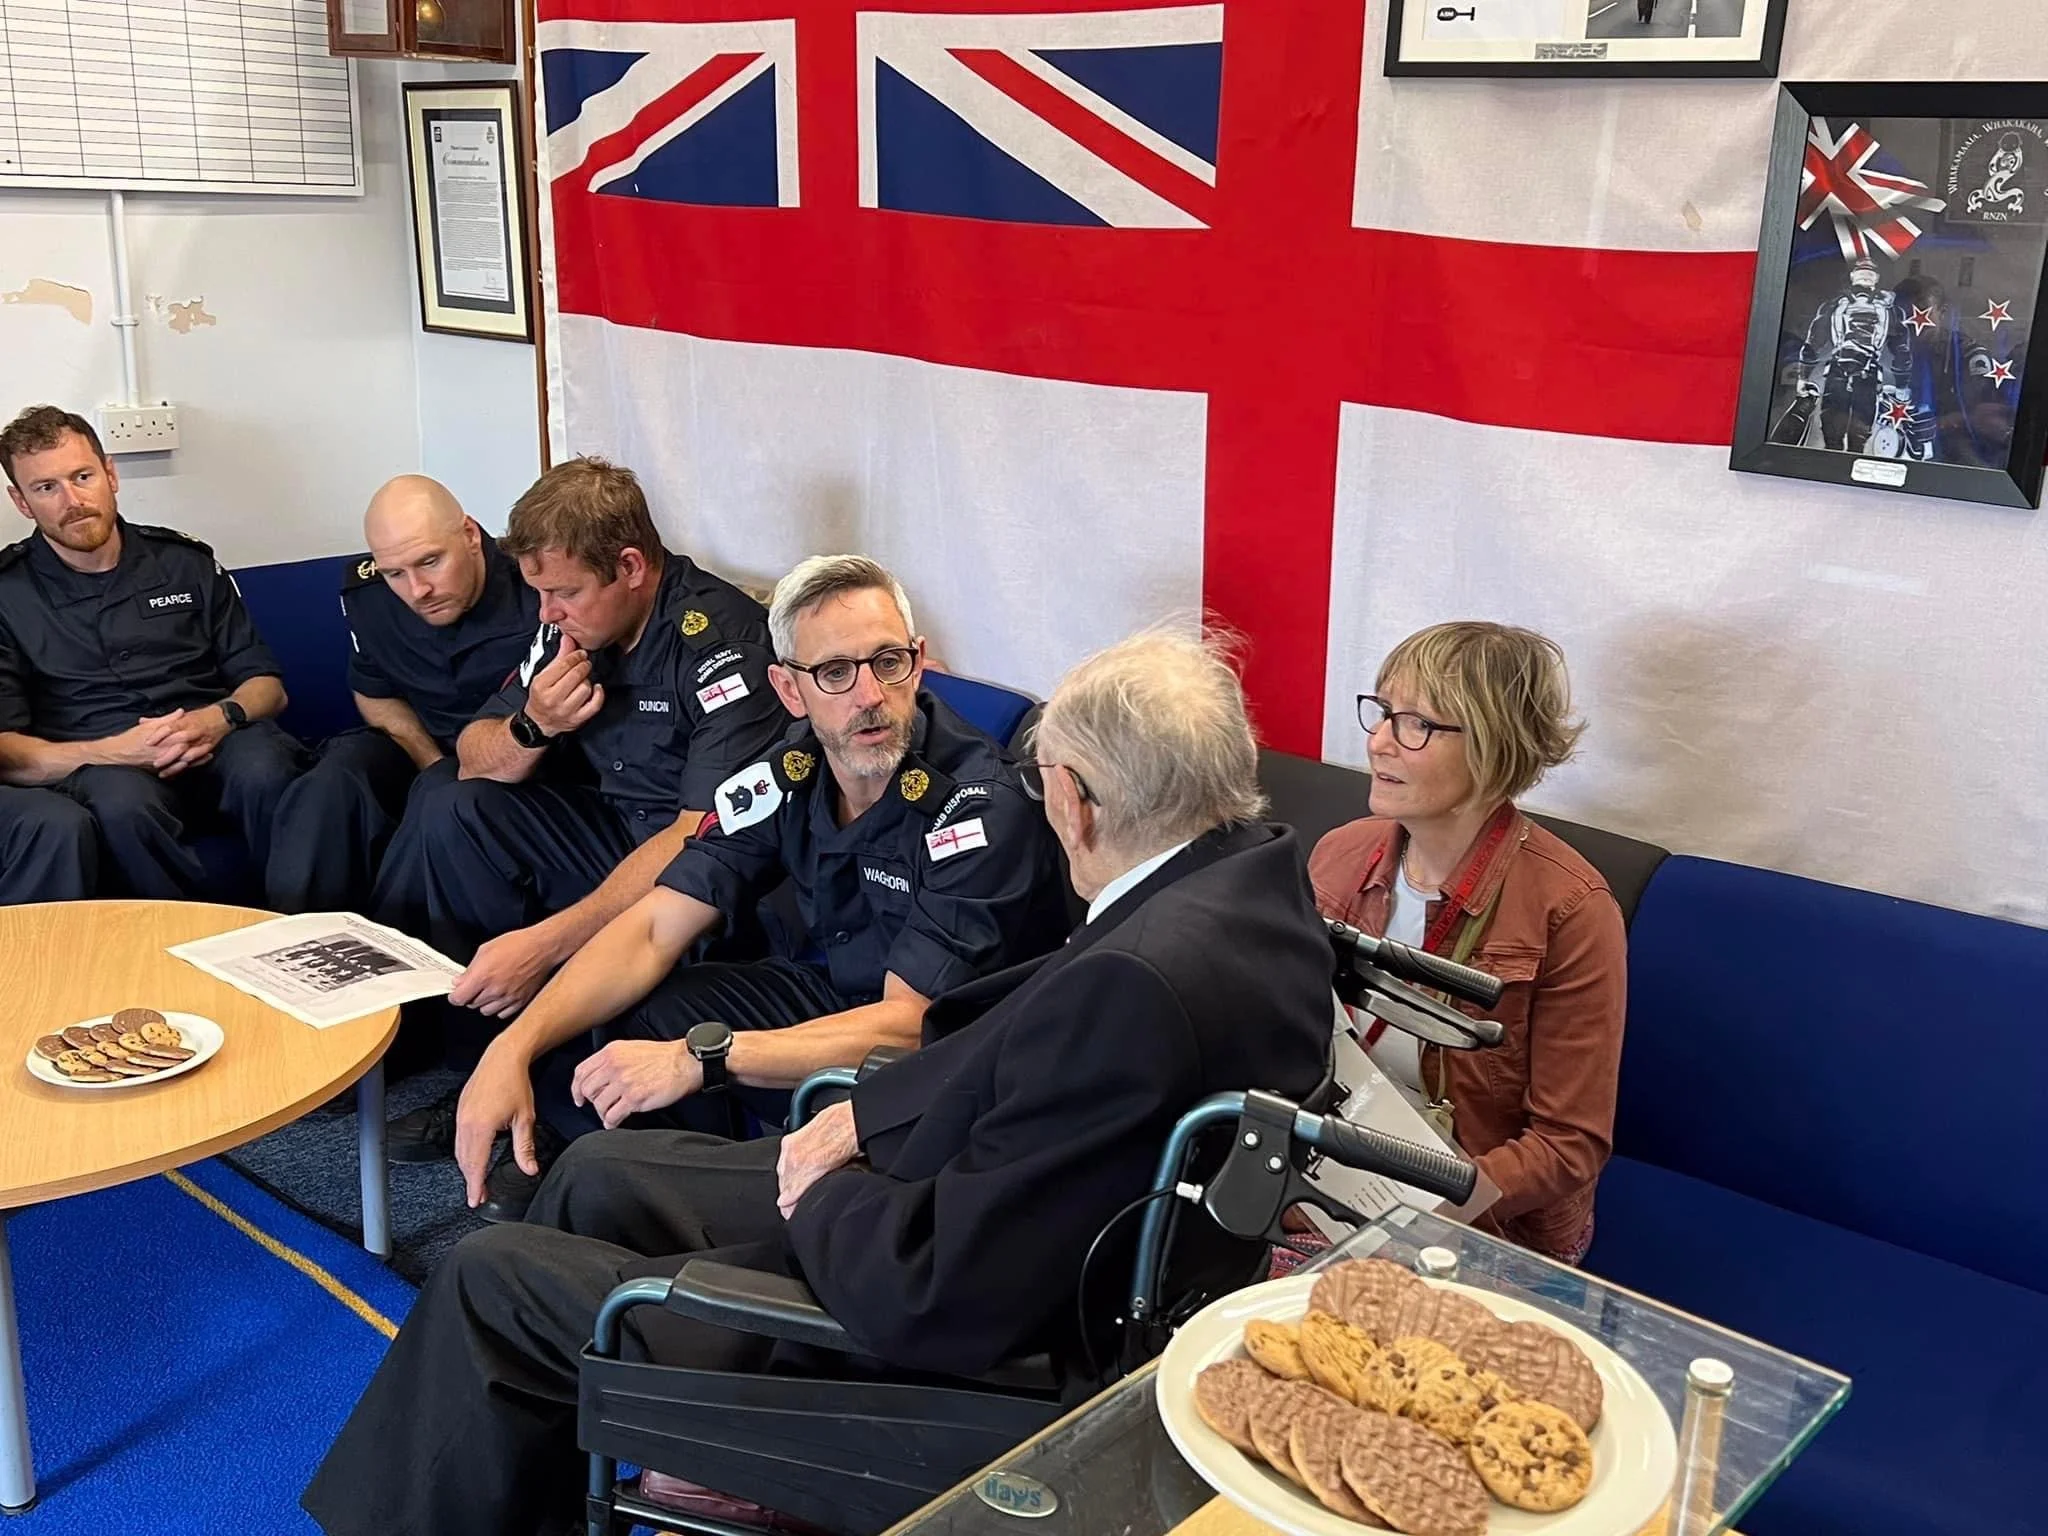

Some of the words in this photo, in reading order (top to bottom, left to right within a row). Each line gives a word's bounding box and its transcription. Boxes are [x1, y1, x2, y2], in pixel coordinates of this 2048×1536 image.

[1983, 212, 2008, 221] RNZN
[148, 593, 193, 608] PEARCE
[697, 657, 716, 674] ROYAL
[714, 649, 732, 660] NAVY
[697, 668, 714, 684] BOMB
[712, 653, 744, 670] DISPOSAL
[638, 700, 670, 713] DUNCAN
[932, 813, 948, 832] OMB
[944, 786, 988, 815] DISPOSAL
[863, 867, 910, 893] WAGHORN
